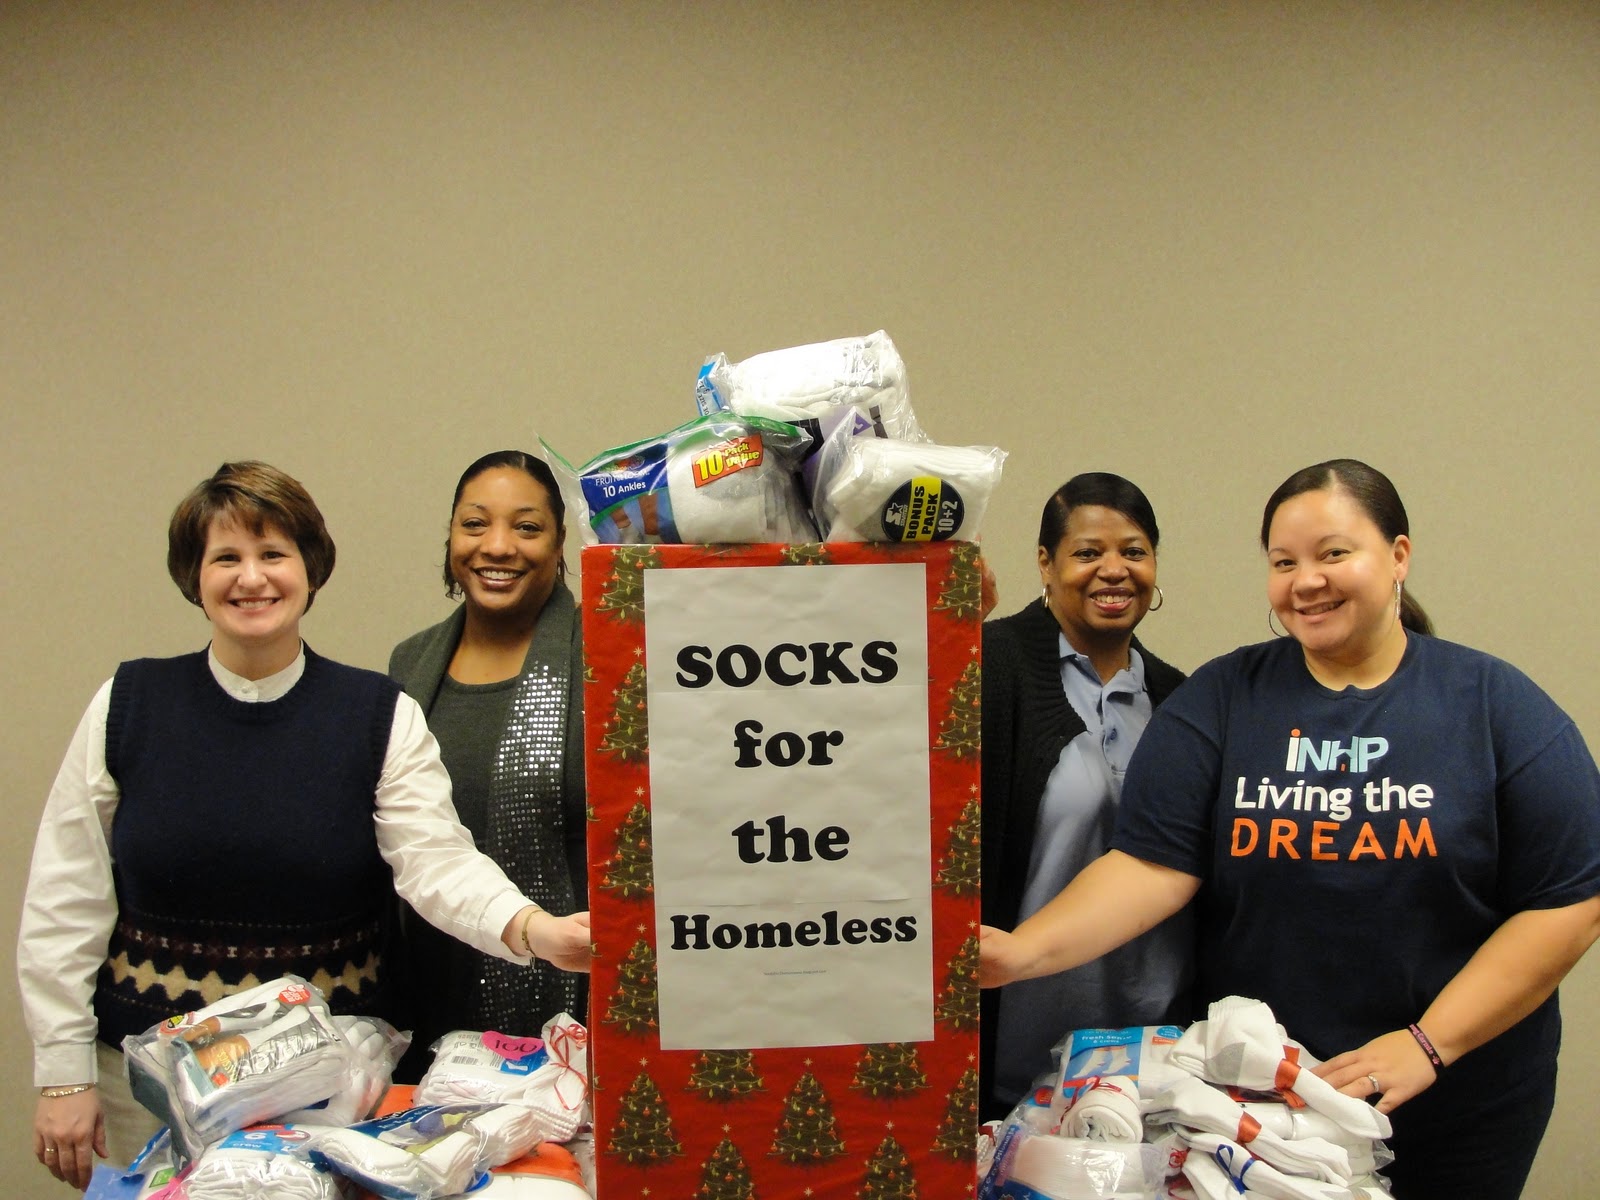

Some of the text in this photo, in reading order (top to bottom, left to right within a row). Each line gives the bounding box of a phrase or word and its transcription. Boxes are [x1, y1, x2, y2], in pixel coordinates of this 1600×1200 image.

[695, 450, 724, 480] 10
[724, 442, 749, 457] Pack
[603, 481, 647, 498] 10 Ankles
[906, 485, 925, 539] BONUS
[921, 493, 939, 535] PACK
[938, 500, 958, 533] 10+2
[675, 640, 899, 689] SOCKS
[733, 719, 844, 769] for
[1234, 776, 1435, 823] Living the
[731, 815, 850, 864] the
[1230, 817, 1438, 861] DREAM
[669, 910, 918, 951] Homeless
[495, 1039, 537, 1052] 100
